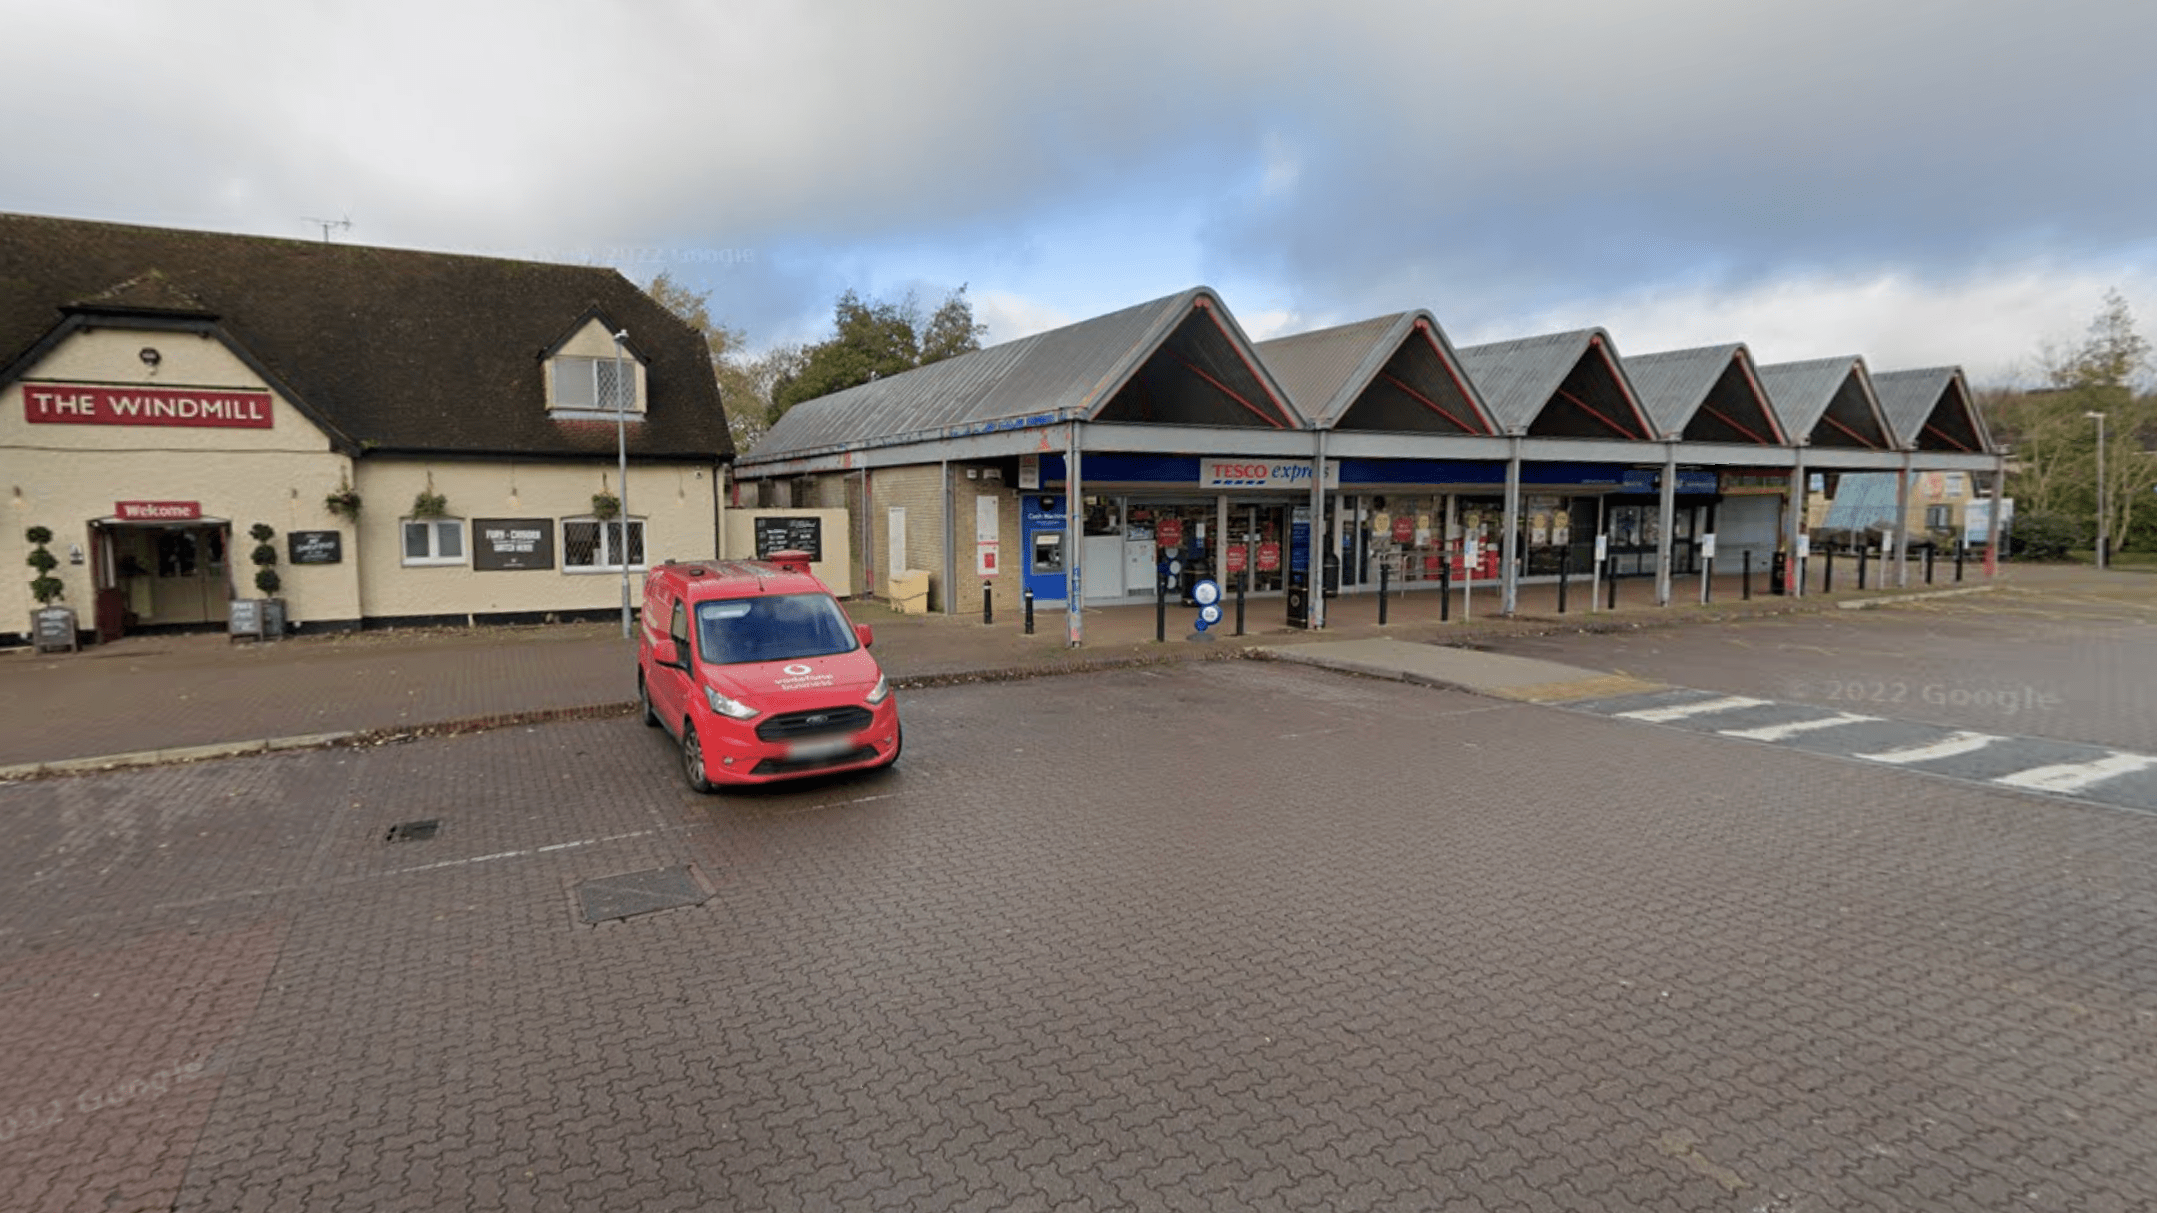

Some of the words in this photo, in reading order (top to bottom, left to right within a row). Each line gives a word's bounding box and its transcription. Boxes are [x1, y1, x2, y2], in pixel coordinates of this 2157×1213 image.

[31, 393, 96, 415] THE
[107, 395, 264, 420] WINDMILL
[1212, 463, 1269, 479] TESCO
[1271, 462, 1330, 483] exprs
[123, 503, 192, 518] Welcome
